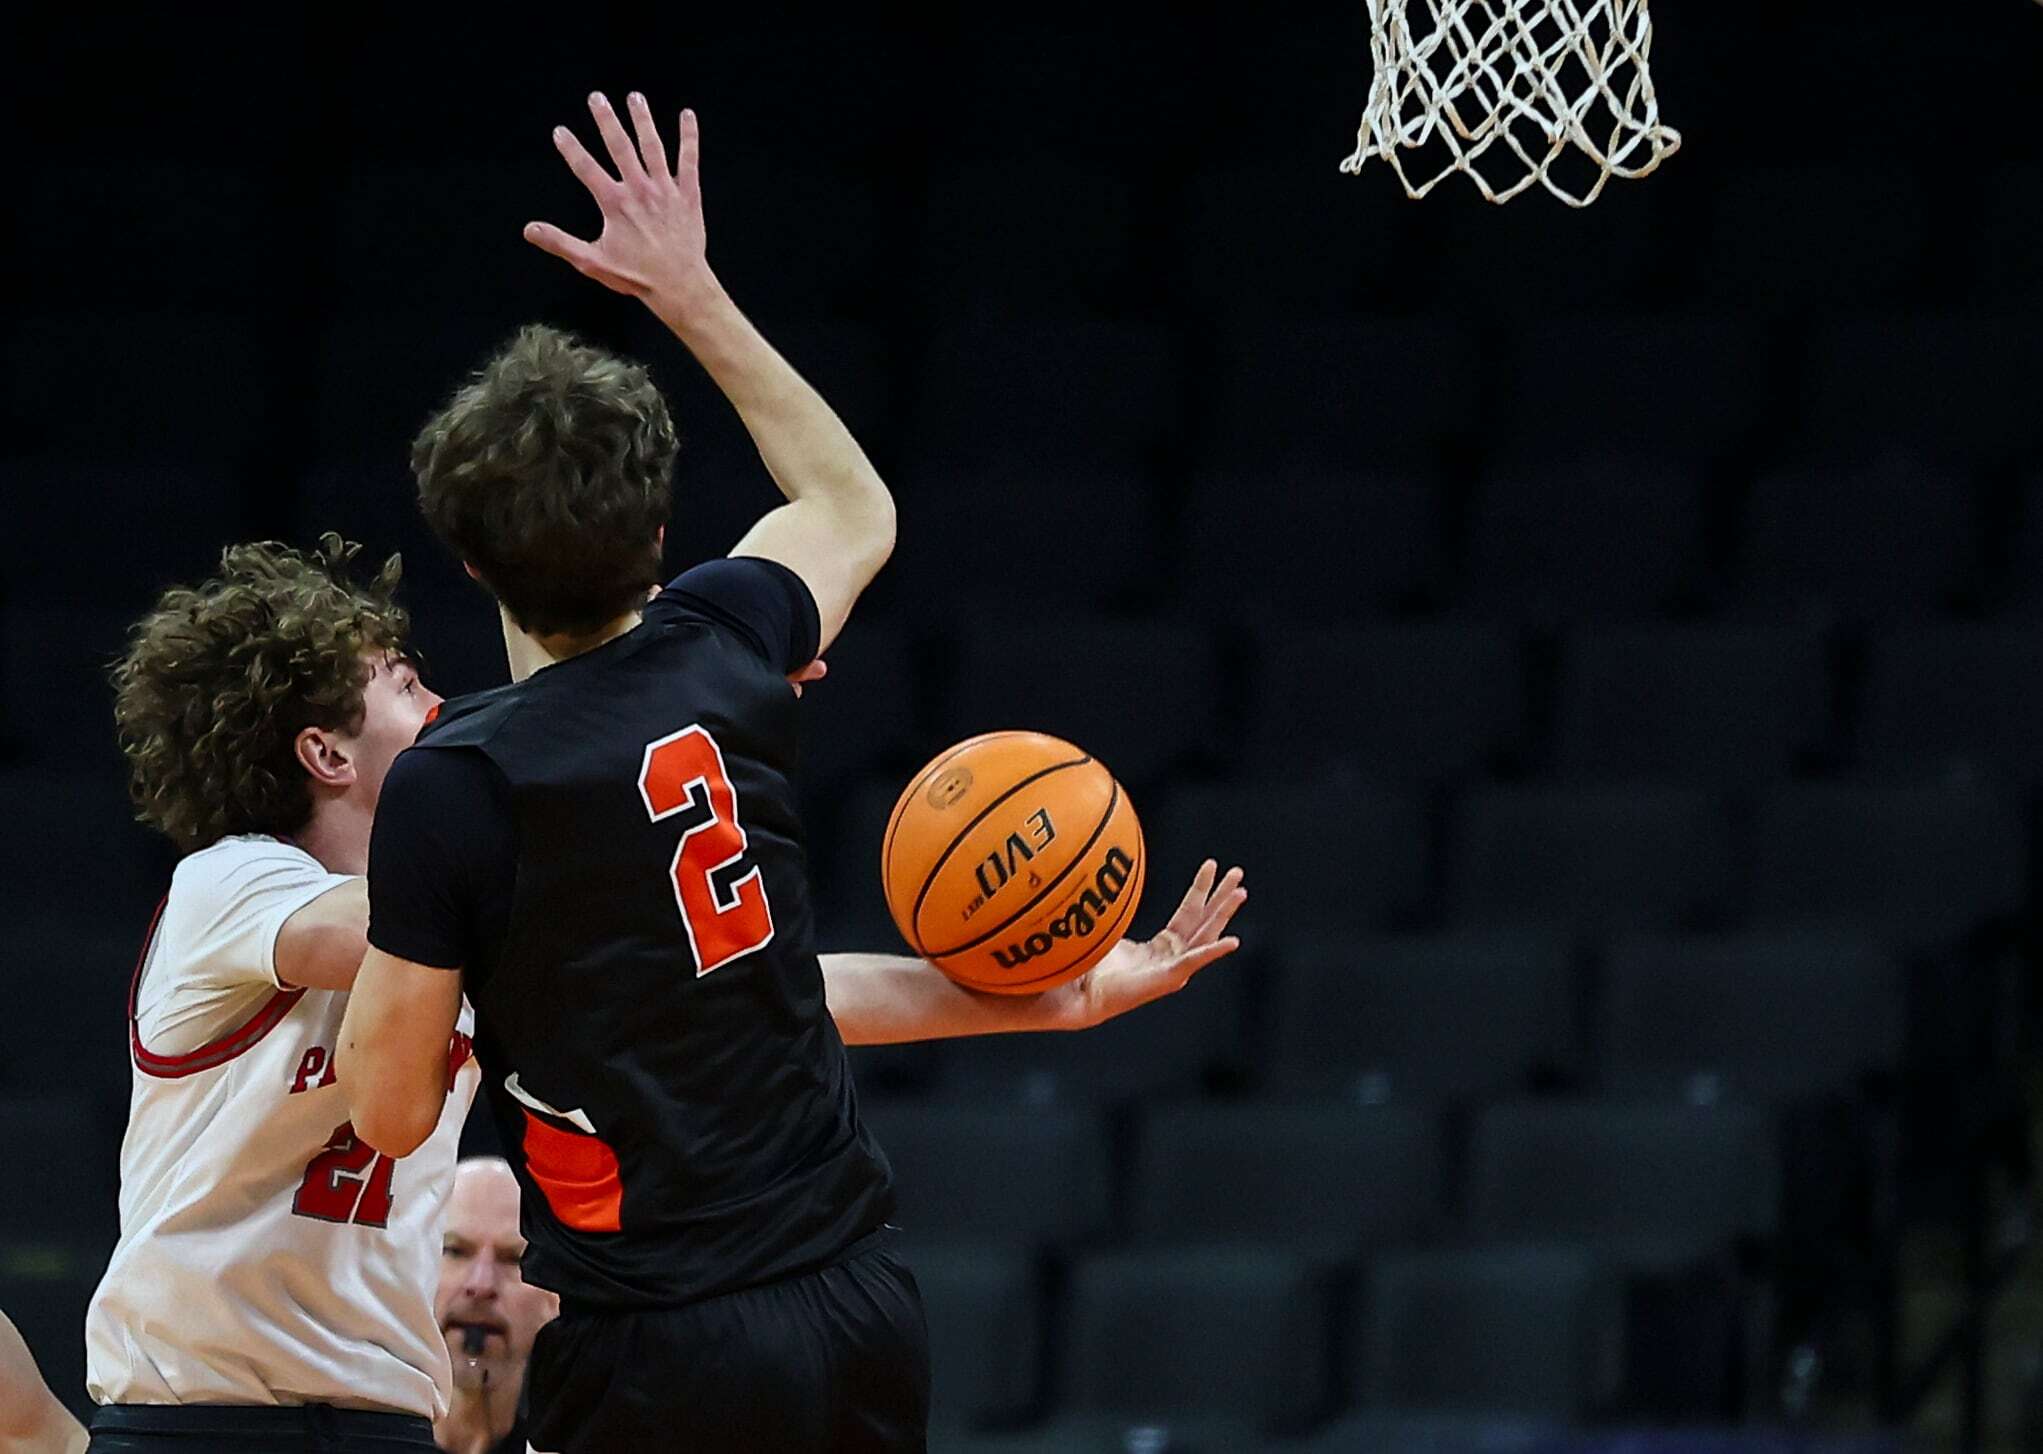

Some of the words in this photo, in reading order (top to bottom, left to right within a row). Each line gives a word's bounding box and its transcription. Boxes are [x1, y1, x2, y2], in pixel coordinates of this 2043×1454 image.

[637, 723, 774, 978] 2
[975, 808, 1056, 899] EVO
[990, 846, 1135, 969] Wilson
[292, 1120, 395, 1229] 21
